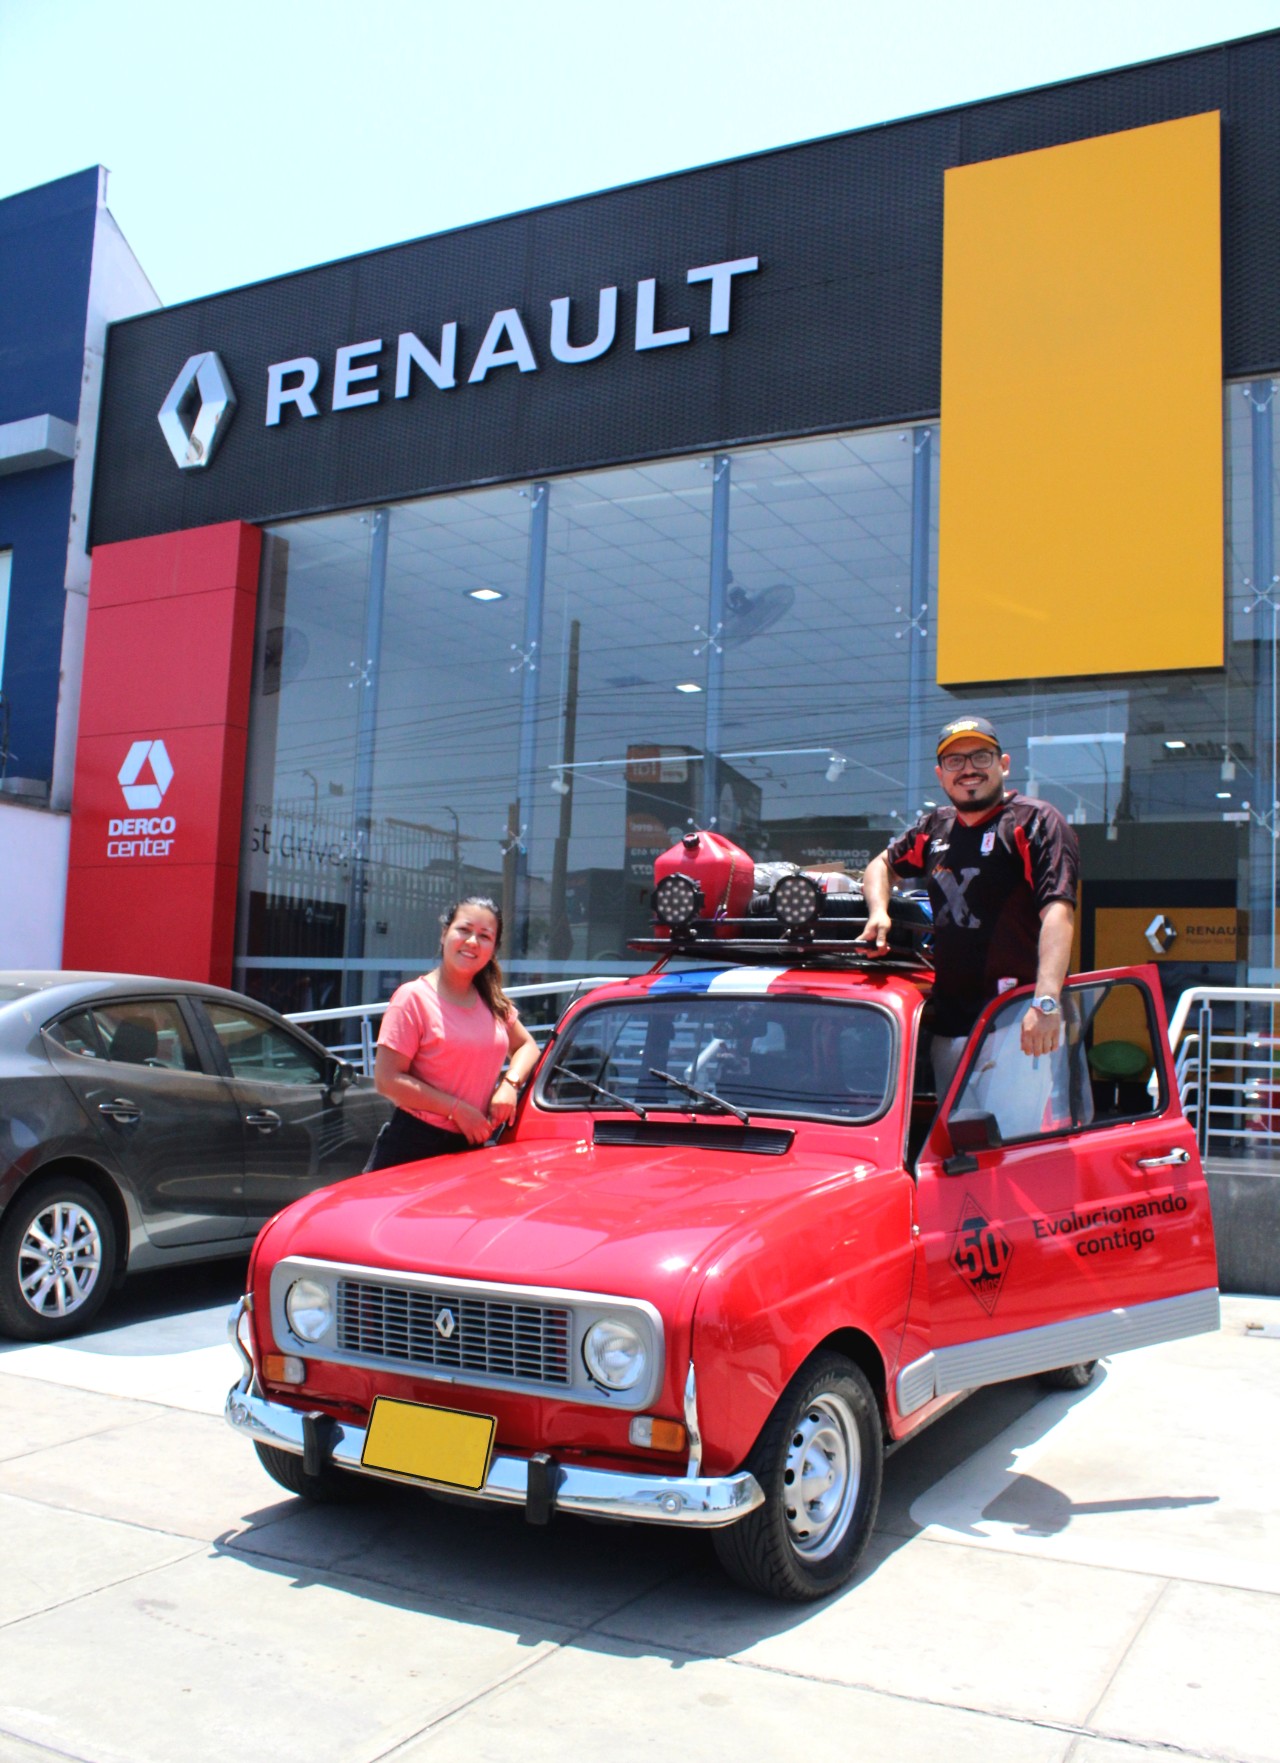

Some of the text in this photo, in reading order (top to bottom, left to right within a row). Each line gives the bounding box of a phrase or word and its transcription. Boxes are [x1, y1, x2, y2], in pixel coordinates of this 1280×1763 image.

[265, 256, 759, 427] RENAULT
[108, 816, 176, 836] DERCO
[107, 838, 175, 858] center
[1033, 1194, 1188, 1239] Evolucionando
[957, 1226, 1003, 1280] 50
[1076, 1228, 1155, 1257] contigo
